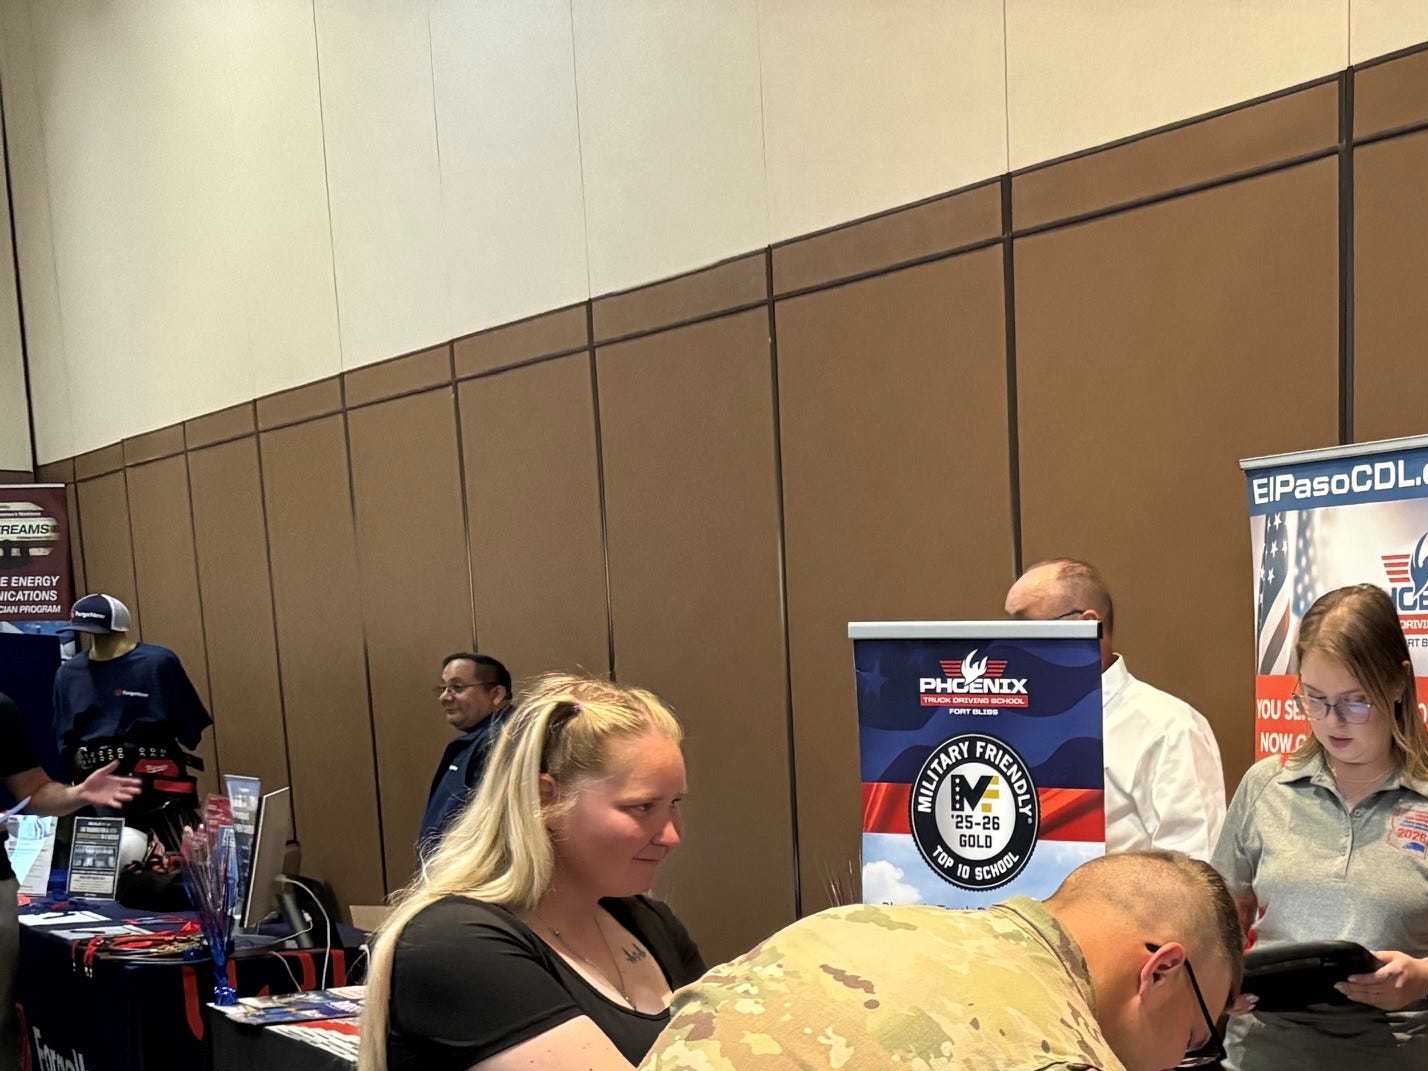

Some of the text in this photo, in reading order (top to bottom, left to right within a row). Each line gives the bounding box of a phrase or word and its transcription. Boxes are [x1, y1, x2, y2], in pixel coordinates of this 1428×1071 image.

[0, 524, 49, 535] REAMS
[11, 576, 60, 587] ENERGY
[19, 605, 61, 614] PROGRAM
[1407, 638, 1420, 648] RT
[920, 678, 1028, 694] PHOENIX
[923, 696, 951, 704] TRUCK
[990, 697, 1025, 705] SCHOOL
[973, 708, 998, 716] BLISS
[1257, 698, 1281, 720] YOU
[1260, 732, 1293, 754] NOW
[918, 741, 970, 813] MILITARY
[959, 834, 993, 849] GOLD
[932, 845, 1020, 881] TOP 10 SCHOOL
